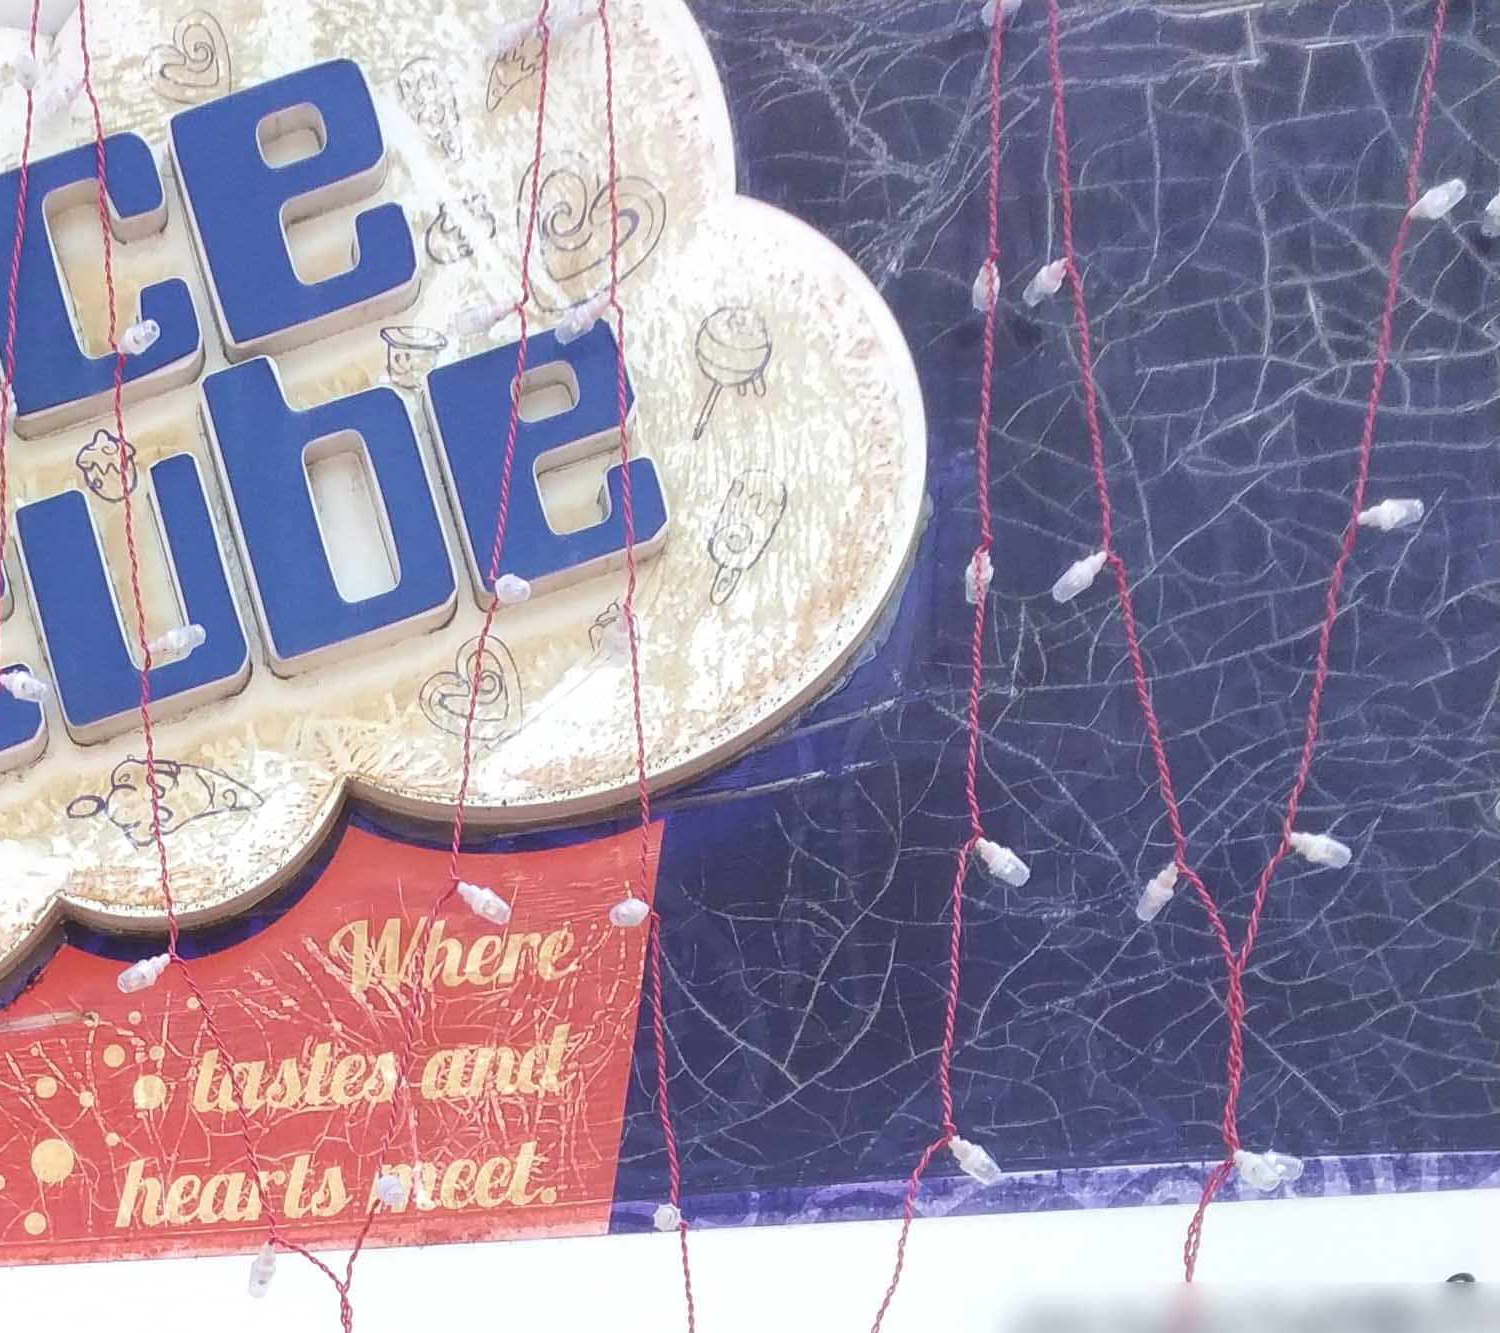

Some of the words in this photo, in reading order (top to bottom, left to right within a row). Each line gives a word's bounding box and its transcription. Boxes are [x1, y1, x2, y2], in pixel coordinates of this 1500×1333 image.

[331, 918, 578, 992] Where
[192, 1036, 398, 1113] tastes
[421, 1023, 572, 1099] and
[115, 1154, 353, 1229] hearts
